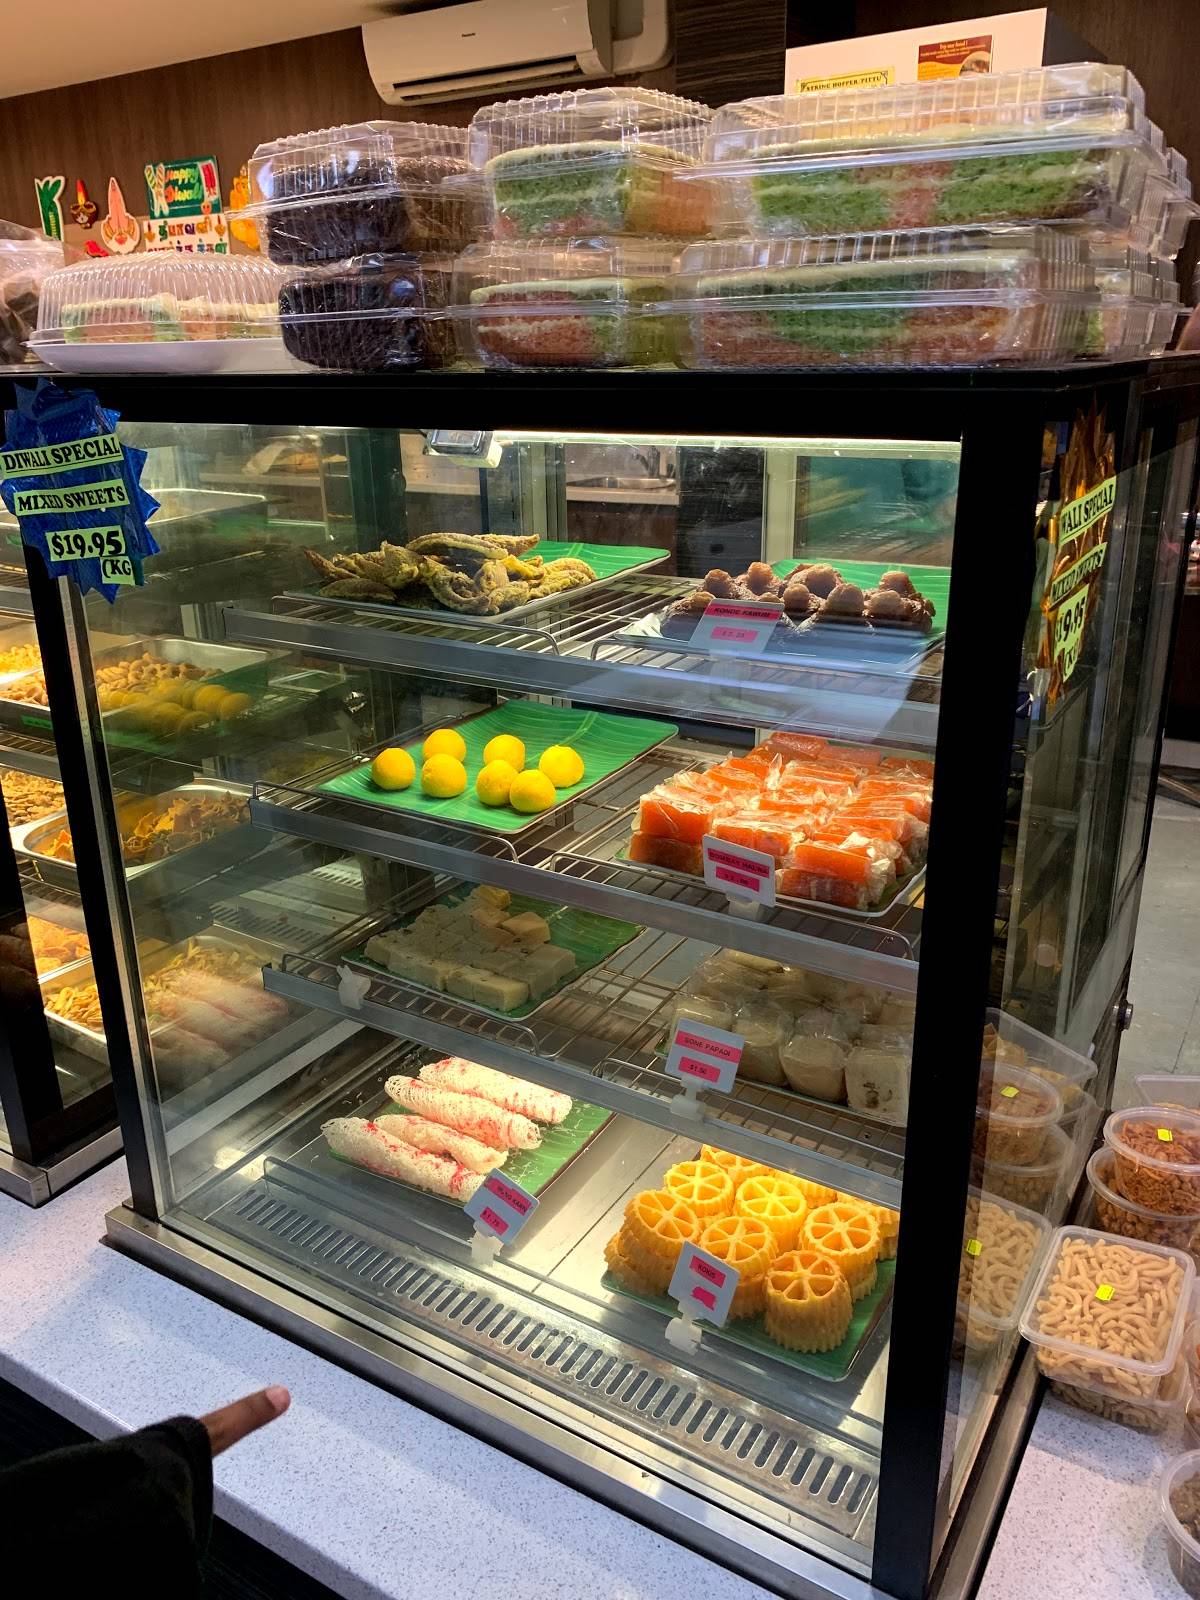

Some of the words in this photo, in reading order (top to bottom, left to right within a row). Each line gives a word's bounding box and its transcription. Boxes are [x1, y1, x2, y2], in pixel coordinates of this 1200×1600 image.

[832, 79, 858, 89] HOPPER
[2, 451, 52, 471] DIWALI
[51, 437, 121, 465] SPECIAL
[17, 492, 64, 512] MIXED
[65, 485, 126, 509] SWEETS
[1084, 484, 1114, 523] SPECIAL
[51, 530, 123, 559] $19.95
[704, 1041, 732, 1057] PAPADI
